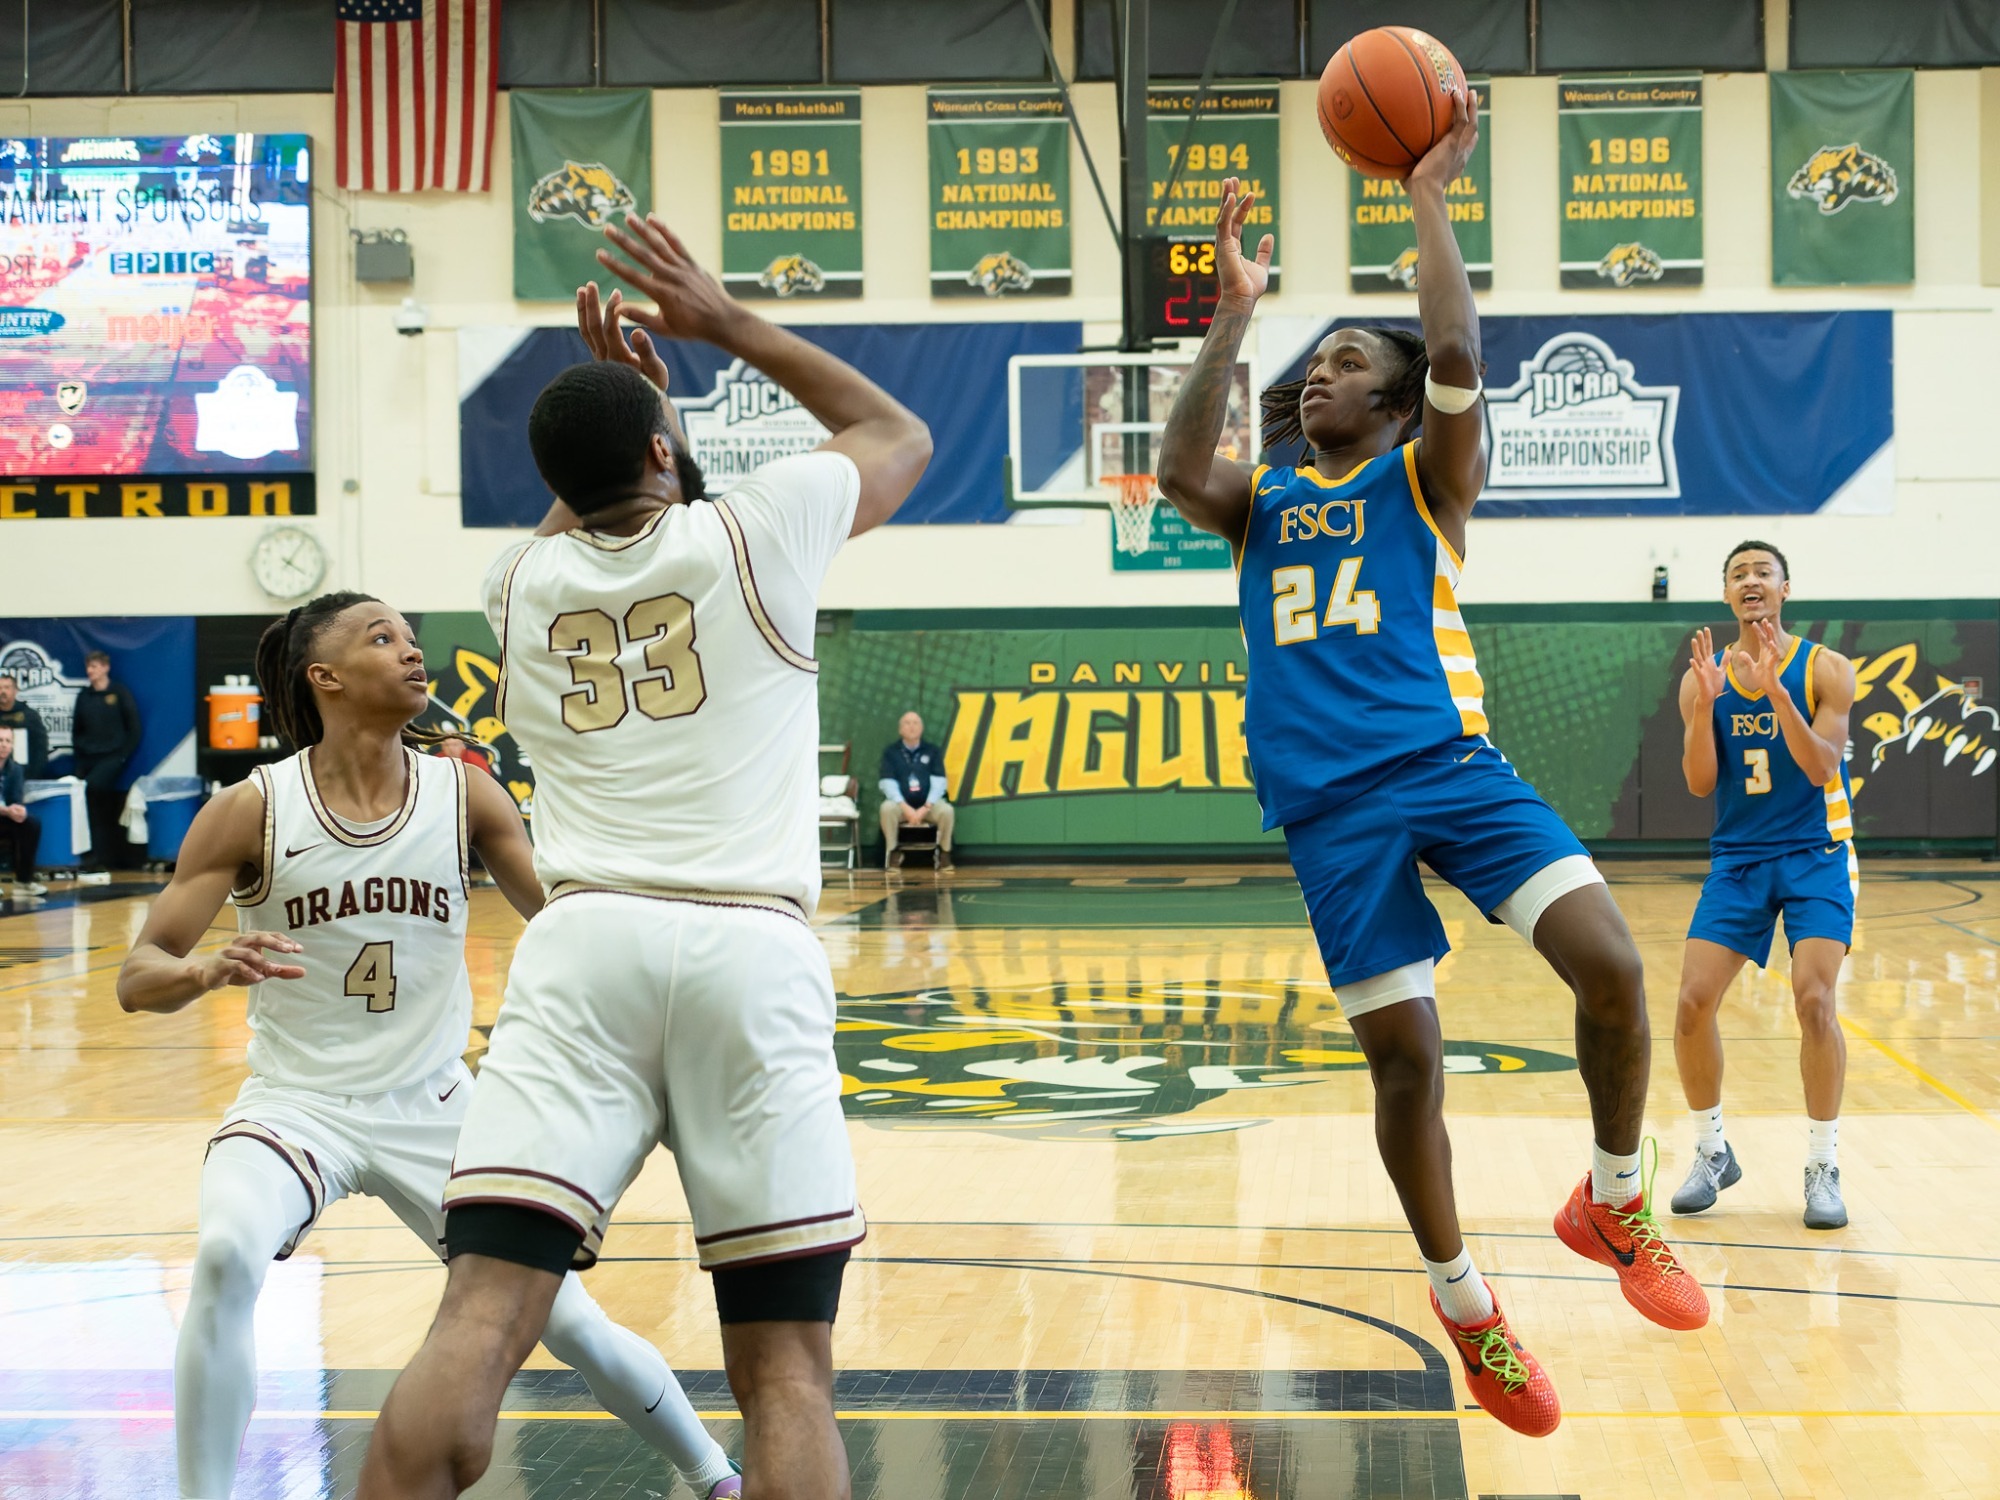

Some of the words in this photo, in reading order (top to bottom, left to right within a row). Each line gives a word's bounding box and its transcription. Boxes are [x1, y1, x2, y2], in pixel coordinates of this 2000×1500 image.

[933, 101, 983, 113] Women's
[985, 101, 1018, 113] Cross
[1019, 100, 1064, 113] Country
[1182, 97, 1219, 109] Coss
[1221, 97, 1274, 110] Country
[1565, 90, 1614, 102] Women's
[1617, 91, 1649, 101] Cross
[1651, 90, 1698, 102] Country
[735, 103, 772, 115] Men's
[775, 102, 845, 114] Basketball
[957, 146, 1040, 175] 1993
[1167, 143, 1250, 171] 1994
[1588, 137, 1671, 164] 1996
[750, 149, 830, 176] 1991
[734, 185, 848, 205] NATIONAL
[942, 183, 1056, 203] NATIONAL
[1152, 179, 1267, 200] NATIOAL
[1363, 176, 1478, 199] NATAL
[1573, 173, 1688, 194] NATIONAL
[116, 188, 262, 223] SPONSORS
[1146, 206, 1273, 226] CHAMPNS
[1356, 203, 1485, 224] CHAMONS
[1565, 199, 1696, 220] CHAMPIONS
[727, 211, 856, 231] CHAMPIONS
[936, 208, 1063, 230] CHAMPIONS
[111, 252, 214, 275] EPIC
[107, 306, 218, 351] meijer
[1532, 371, 1620, 418] NJCAA
[697, 438, 742, 447] MEN'S
[1501, 428, 1547, 438] MEN'S
[1553, 427, 1650, 438] BASKETBALL
[1501, 440, 1651, 467] CHAMPIONSHIP
[1278, 499, 1366, 546] FSCJ
[1272, 556, 1382, 647] 24
[548, 591, 708, 735] 33
[1030, 662, 1247, 684] DANVIL
[1731, 712, 1780, 740] FSCJ
[1743, 748, 1773, 796] 3
[284, 876, 450, 931] DRAGONS
[343, 940, 398, 1013] 4
